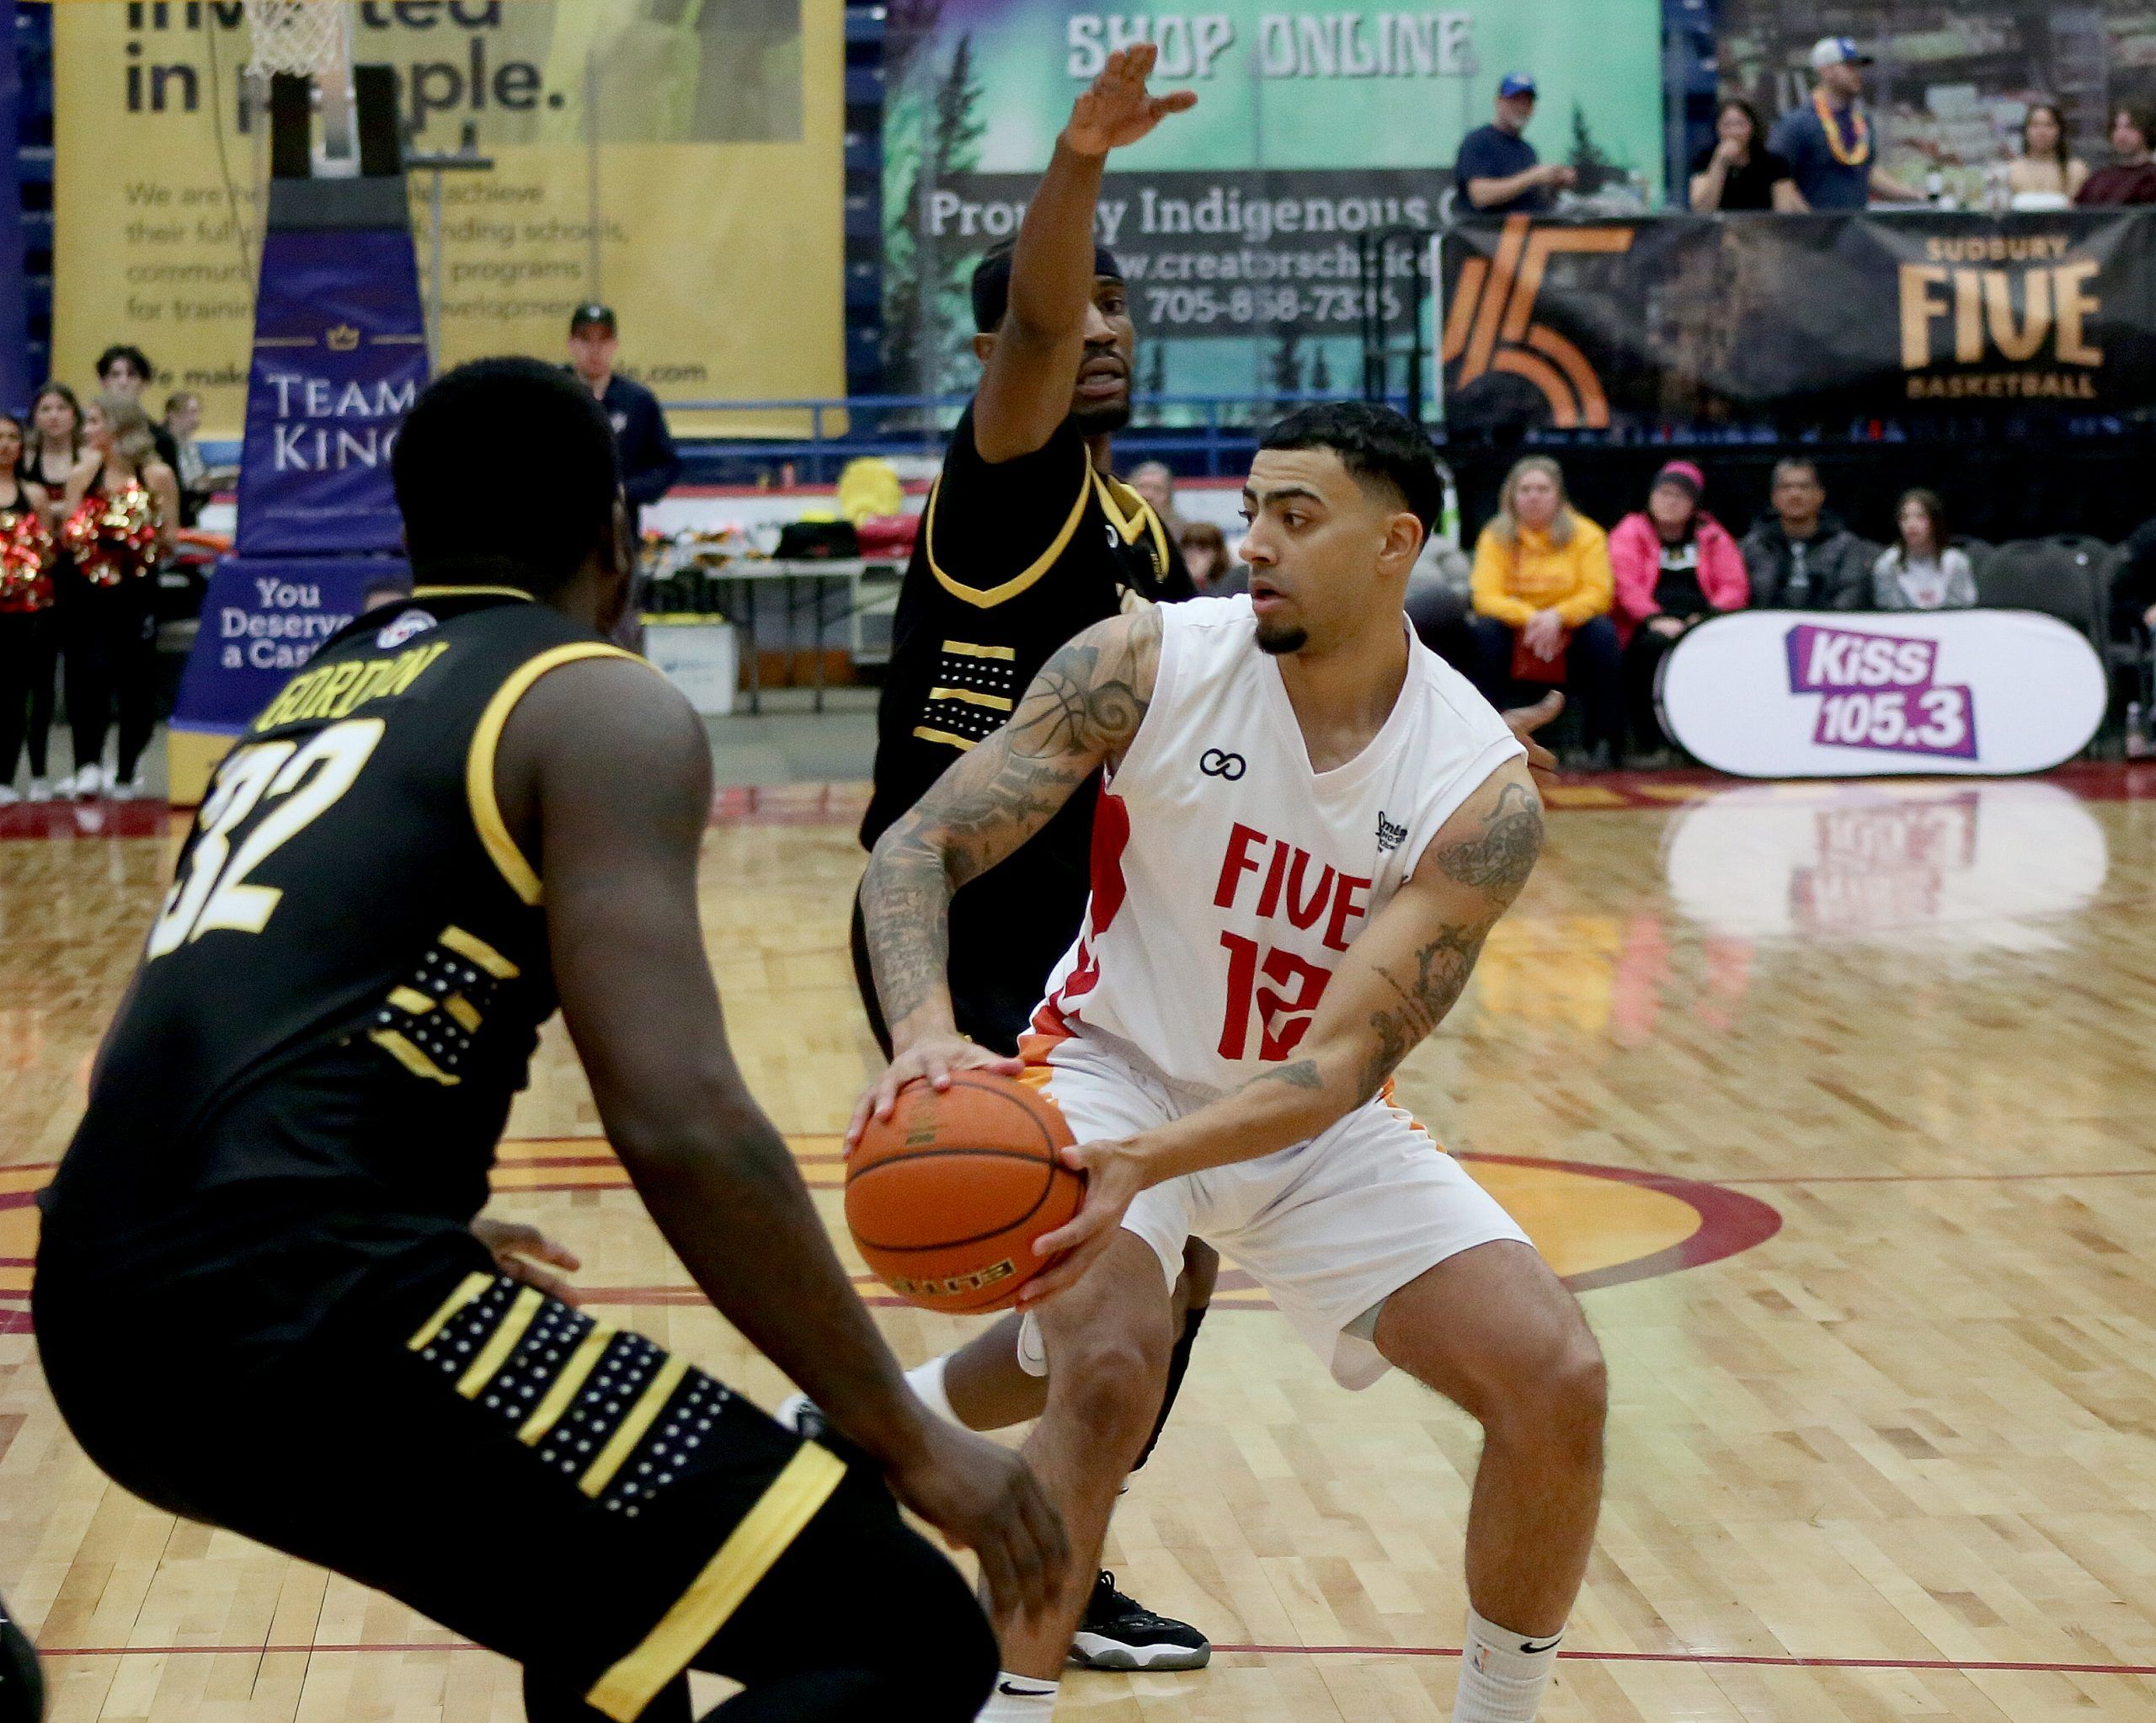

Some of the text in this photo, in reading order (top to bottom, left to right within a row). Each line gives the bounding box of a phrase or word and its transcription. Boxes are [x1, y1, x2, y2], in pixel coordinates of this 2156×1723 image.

[1066, 11, 1476, 79] SHOP ONLINE
[125, 41, 199, 112] in
[125, 182, 171, 205] We
[930, 189, 1128, 245] Proy
[1139, 186, 1431, 243] Indigenous
[1926, 235, 2068, 262] SUDBURY
[1898, 259, 2105, 371] FIVE
[266, 375, 418, 419] TEAM
[1905, 373, 2098, 400] BASKETBALL
[255, 577, 323, 609] You
[221, 644, 245, 669] a
[1823, 688, 1967, 749] 105.3
[147, 716, 387, 963] 32
[1213, 821, 1372, 952] FIVE
[1217, 930, 1332, 1062] 12
